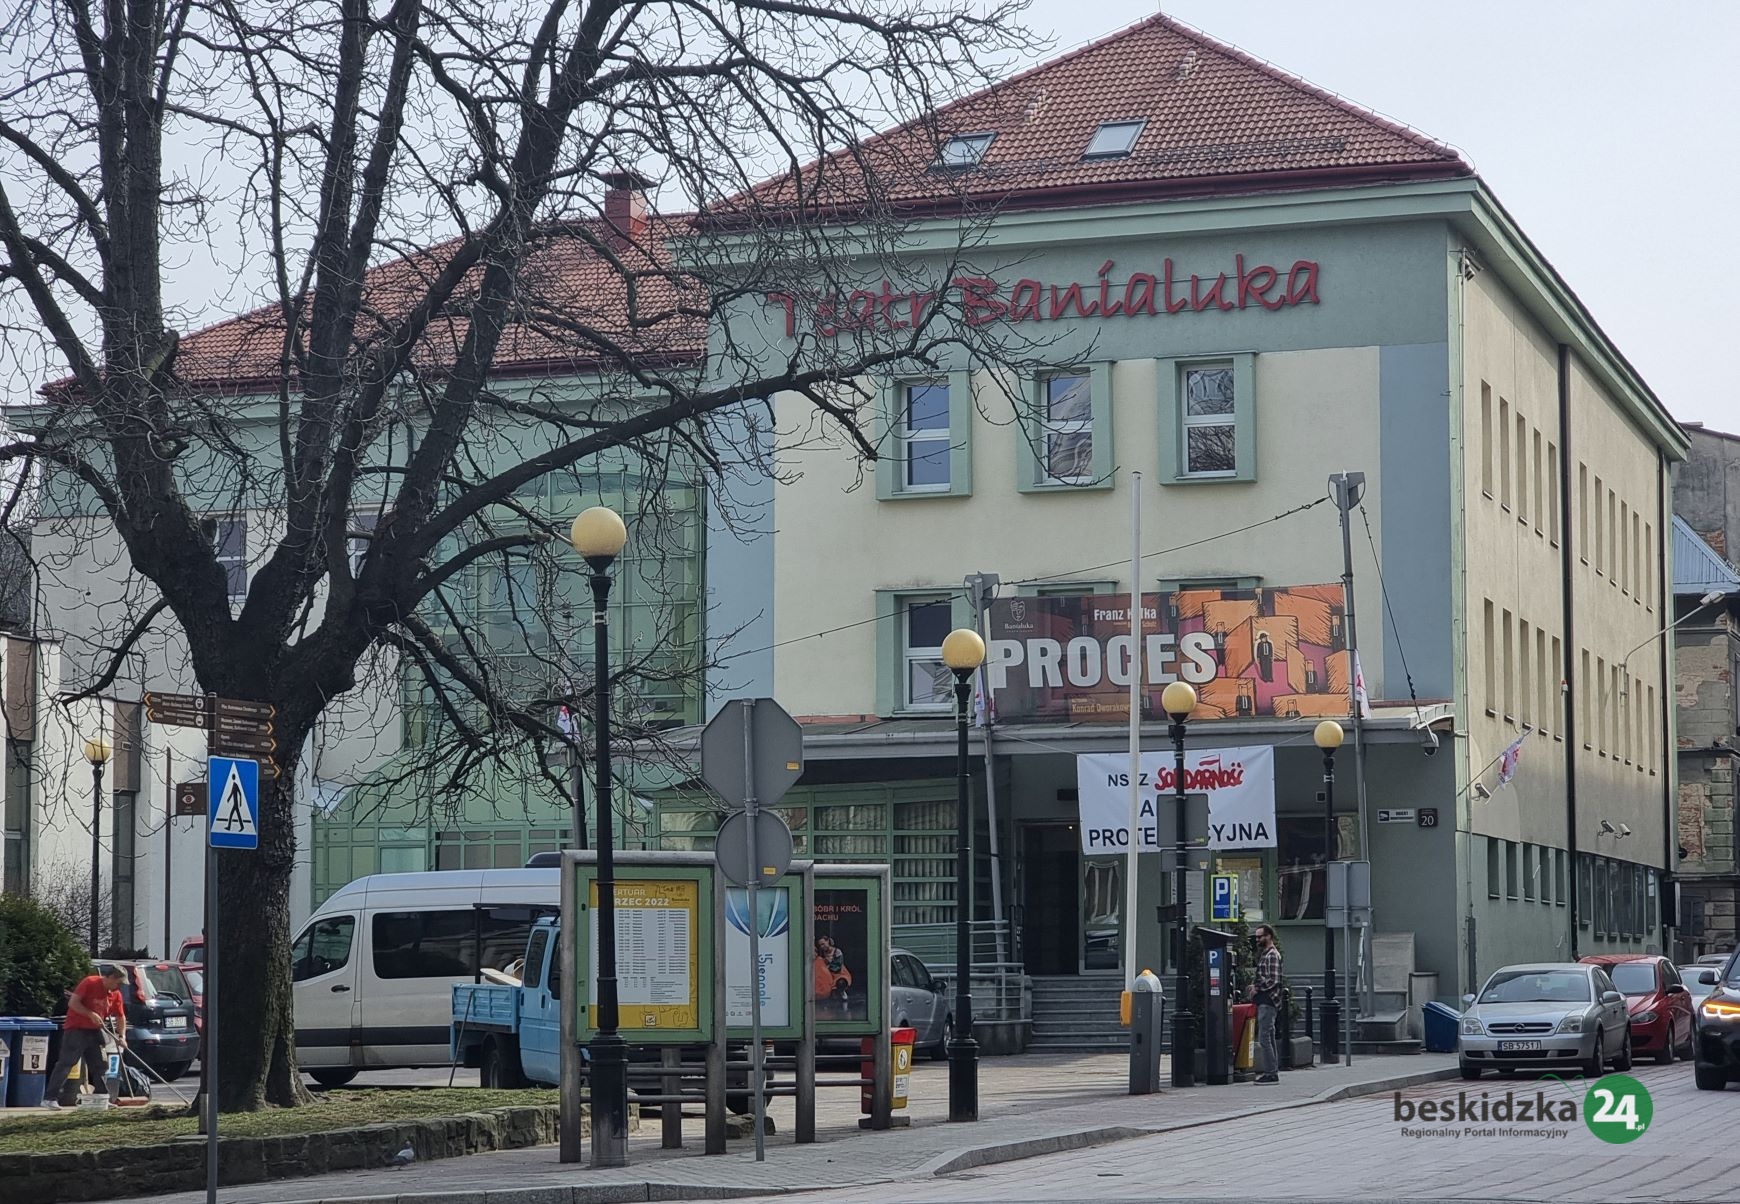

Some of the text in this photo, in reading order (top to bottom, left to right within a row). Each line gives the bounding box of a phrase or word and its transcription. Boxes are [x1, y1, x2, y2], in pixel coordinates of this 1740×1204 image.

[952, 253, 1321, 328] Banialuka
[1093, 608, 1124, 621] Franz
[991, 632, 1218, 690] PROCES
[1108, 773, 1150, 788] NSZ
[1421, 815, 1435, 826] 20
[1215, 878, 1229, 901] P
[645, 898, 670, 906] 2022
[1503, 1042, 1514, 1050] SB
